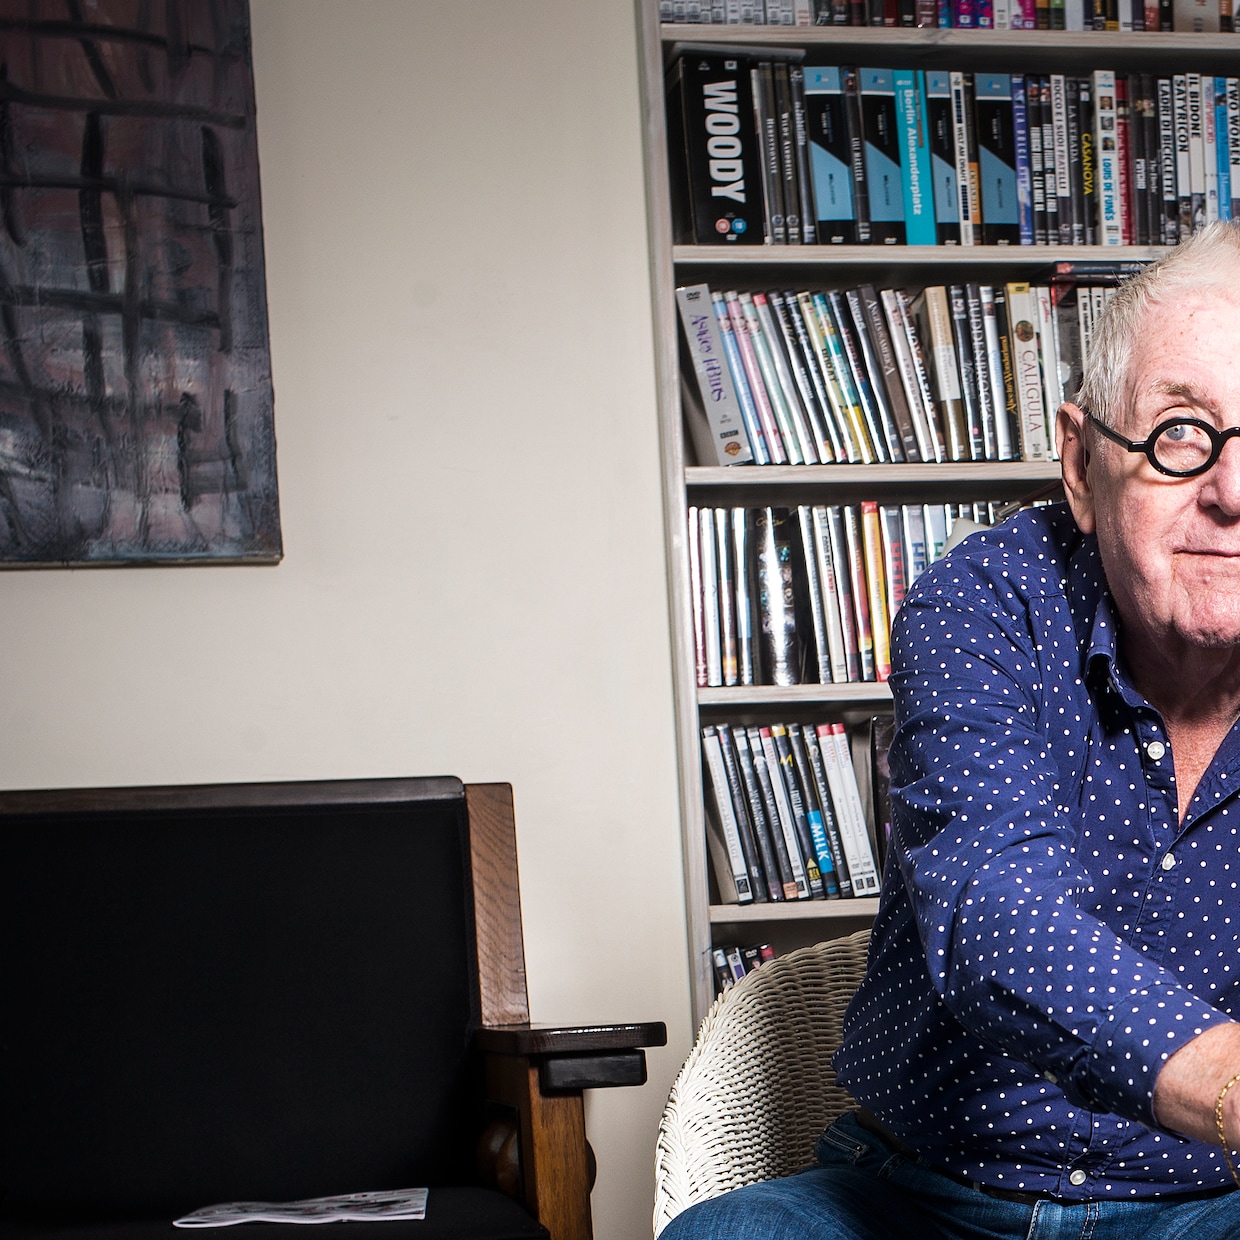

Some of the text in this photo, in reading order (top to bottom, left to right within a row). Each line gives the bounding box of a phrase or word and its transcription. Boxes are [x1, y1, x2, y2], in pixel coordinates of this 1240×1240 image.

[1053, 78, 1063, 109] ROCCO
[1175, 80, 1189, 152] SATYRICON
[1188, 75, 1202, 138] IL BIDONE
[1229, 81, 1240, 110] TWO
[703, 80, 746, 203] WOODY
[904, 89, 922, 215] Berlin Alexanderplatz
[957, 126, 968, 182] WELT AM DRAHT
[1055, 124, 1064, 147] SUOI
[1068, 105, 1079, 164] LA STRADA
[1081, 133, 1093, 195] CASANOVA
[1159, 82, 1174, 195] LADRI DI BICICLETTE
[1057, 149, 1067, 190] FRATELLI
[1102, 158, 1113, 191] LOUIS DE
[1136, 159, 1146, 189] PSYCHO
[866, 299, 896, 376] ANGELS AMERICA
[969, 298, 994, 422] BUDDENBROOKS
[998, 335, 1014, 384] Wonderland
[1021, 350, 1042, 433] CALIGULA
[780, 754, 793, 767] M
[811, 823, 829, 861] MILK
[818, 782, 829, 809] Leben
[824, 811, 833, 827] der
[829, 830, 843, 867] Anderen
